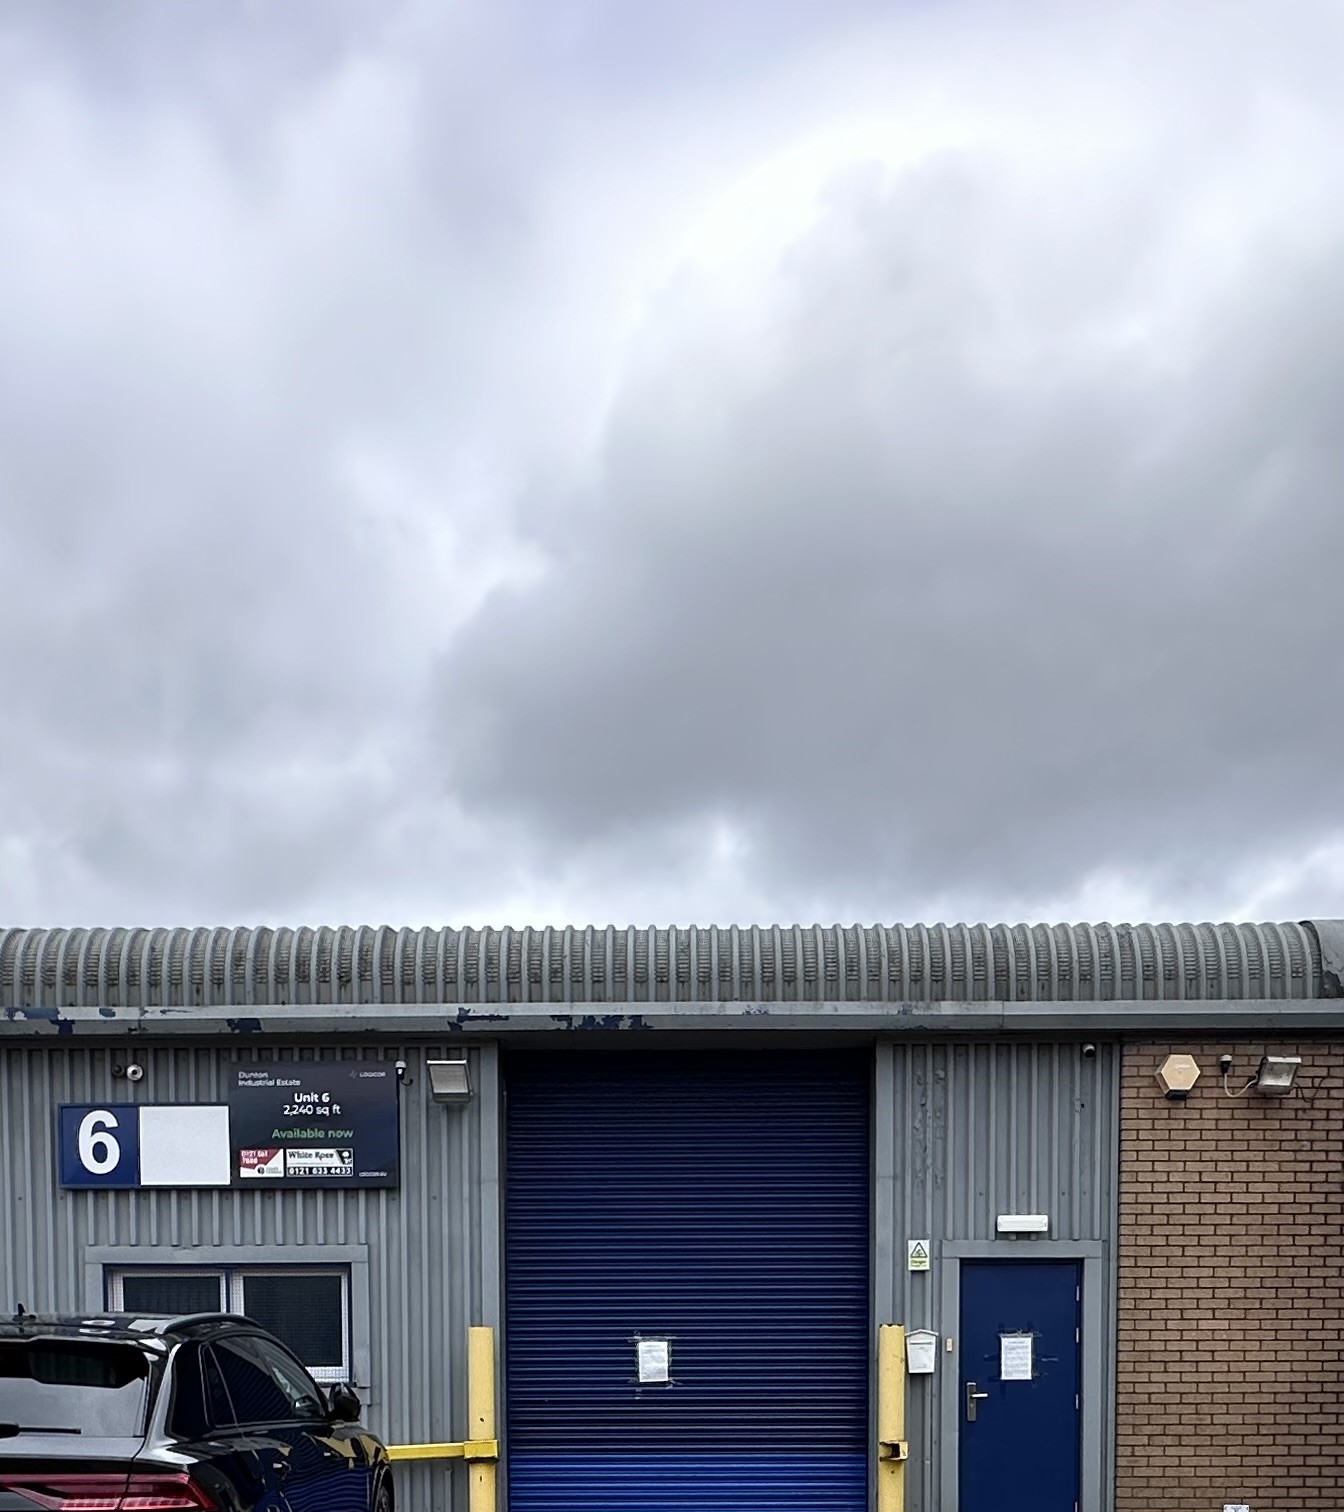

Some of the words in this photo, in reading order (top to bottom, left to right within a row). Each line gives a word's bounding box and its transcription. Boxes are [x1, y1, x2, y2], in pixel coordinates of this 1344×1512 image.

[238, 1079, 275, 1087] Industrial
[276, 1078, 301, 1086] Estate
[294, 1092, 319, 1103] Unit
[321, 1092, 330, 1103] 6
[283, 1105, 314, 1117] 2,240
[315, 1106, 330, 1116] sq
[332, 1104, 341, 1115] ft
[271, 1128, 325, 1139] Available
[327, 1130, 354, 1139] now
[78, 1109, 121, 1175] 6
[287, 1151, 313, 1159] White
[288, 1167, 309, 1175] 0121
[311, 1167, 328, 1175] 633
[330, 1167, 351, 1175] 4433
